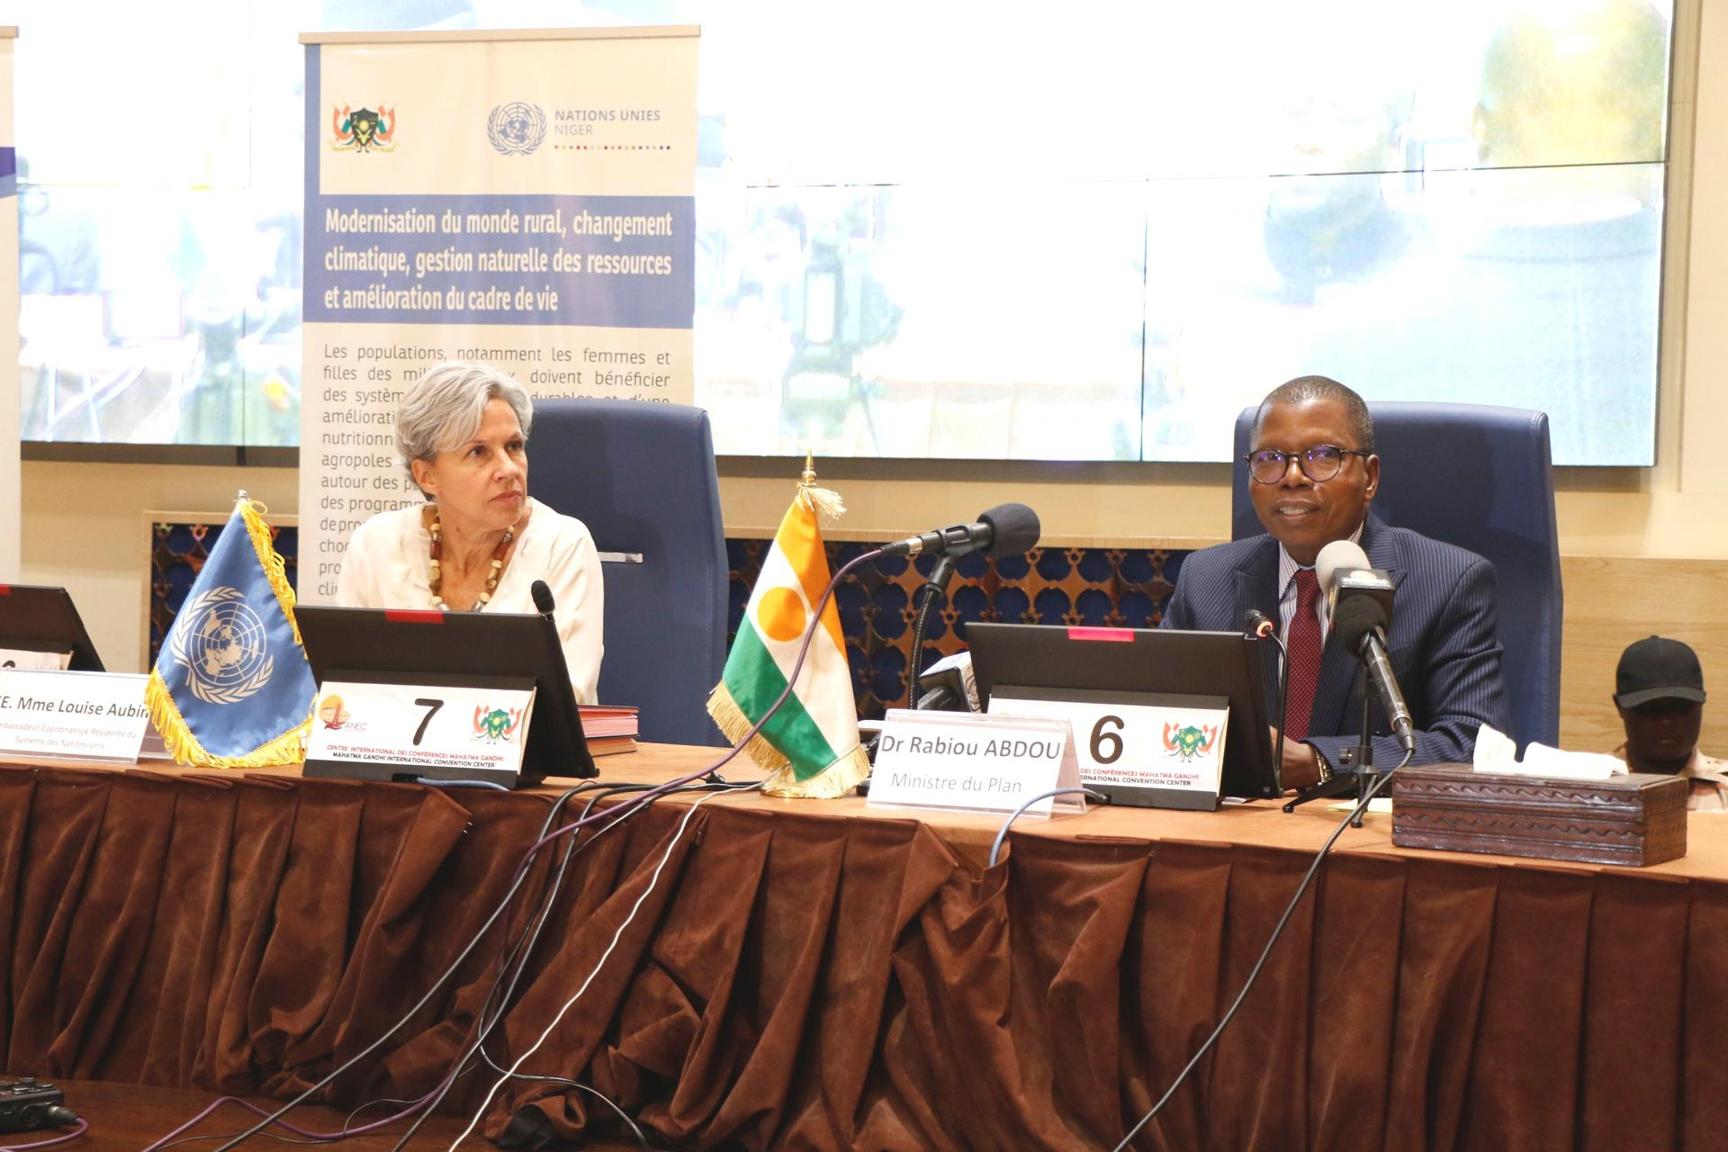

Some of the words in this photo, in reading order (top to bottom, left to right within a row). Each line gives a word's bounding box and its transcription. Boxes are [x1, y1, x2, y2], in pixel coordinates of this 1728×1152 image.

[555, 110, 615, 122] NATIONS
[620, 110, 661, 122] UNIES
[554, 124, 593, 136] NIGER
[325, 207, 436, 233] Modernisation
[441, 208, 462, 234] du
[466, 208, 519, 234] monde
[524, 208, 567, 239] rural,
[573, 209, 673, 242] changement
[324, 245, 410, 278] climatique,
[415, 246, 473, 278] gestion
[478, 247, 549, 272] naturelle
[553, 247, 582, 273] des
[587, 253, 672, 275] ressources
[324, 285, 340, 309] et
[343, 283, 442, 310] amélioration
[446, 285, 465, 311] du
[468, 285, 512, 311] cadre
[515, 286, 534, 311] de
[536, 284, 559, 311] vie
[324, 344, 347, 359] Les
[358, 345, 447, 361] populations,
[457, 347, 542, 362] notamment
[552, 347, 572, 362] les
[583, 348, 646, 365] femmes
[656, 351, 671, 366] et
[323, 365, 357, 381] filles
[367, 366, 392, 381] des
[530, 369, 582, 385] doivent
[595, 370, 671, 387] bénéficier
[323, 388, 347, 402] des
[321, 453, 393, 470] agropoles
[321, 476, 368, 489] autour
[372, 475, 399, 490] des
[320, 495, 344, 510] des
[320, 517, 337, 531] de
[0, 696, 12, 709] E.
[17, 697, 55, 712] Mme
[58, 699, 104, 715] Louise
[412, 698, 444, 746] 7
[881, 735, 904, 752] Dr
[909, 736, 978, 756] Rabiou
[984, 739, 1061, 760] ABDOU
[1090, 715, 1124, 764] 6
[332, 751, 361, 759] MAHATMA
[387, 756, 432, 765] INTERNATIONAL
[434, 759, 471, 767] CONVENTION
[891, 773, 957, 790] Ministre
[962, 776, 982, 792] du
[988, 777, 1022, 793] Plan
[1122, 777, 1165, 785] CONVENTION
[1166, 779, 1192, 787] CENTER
